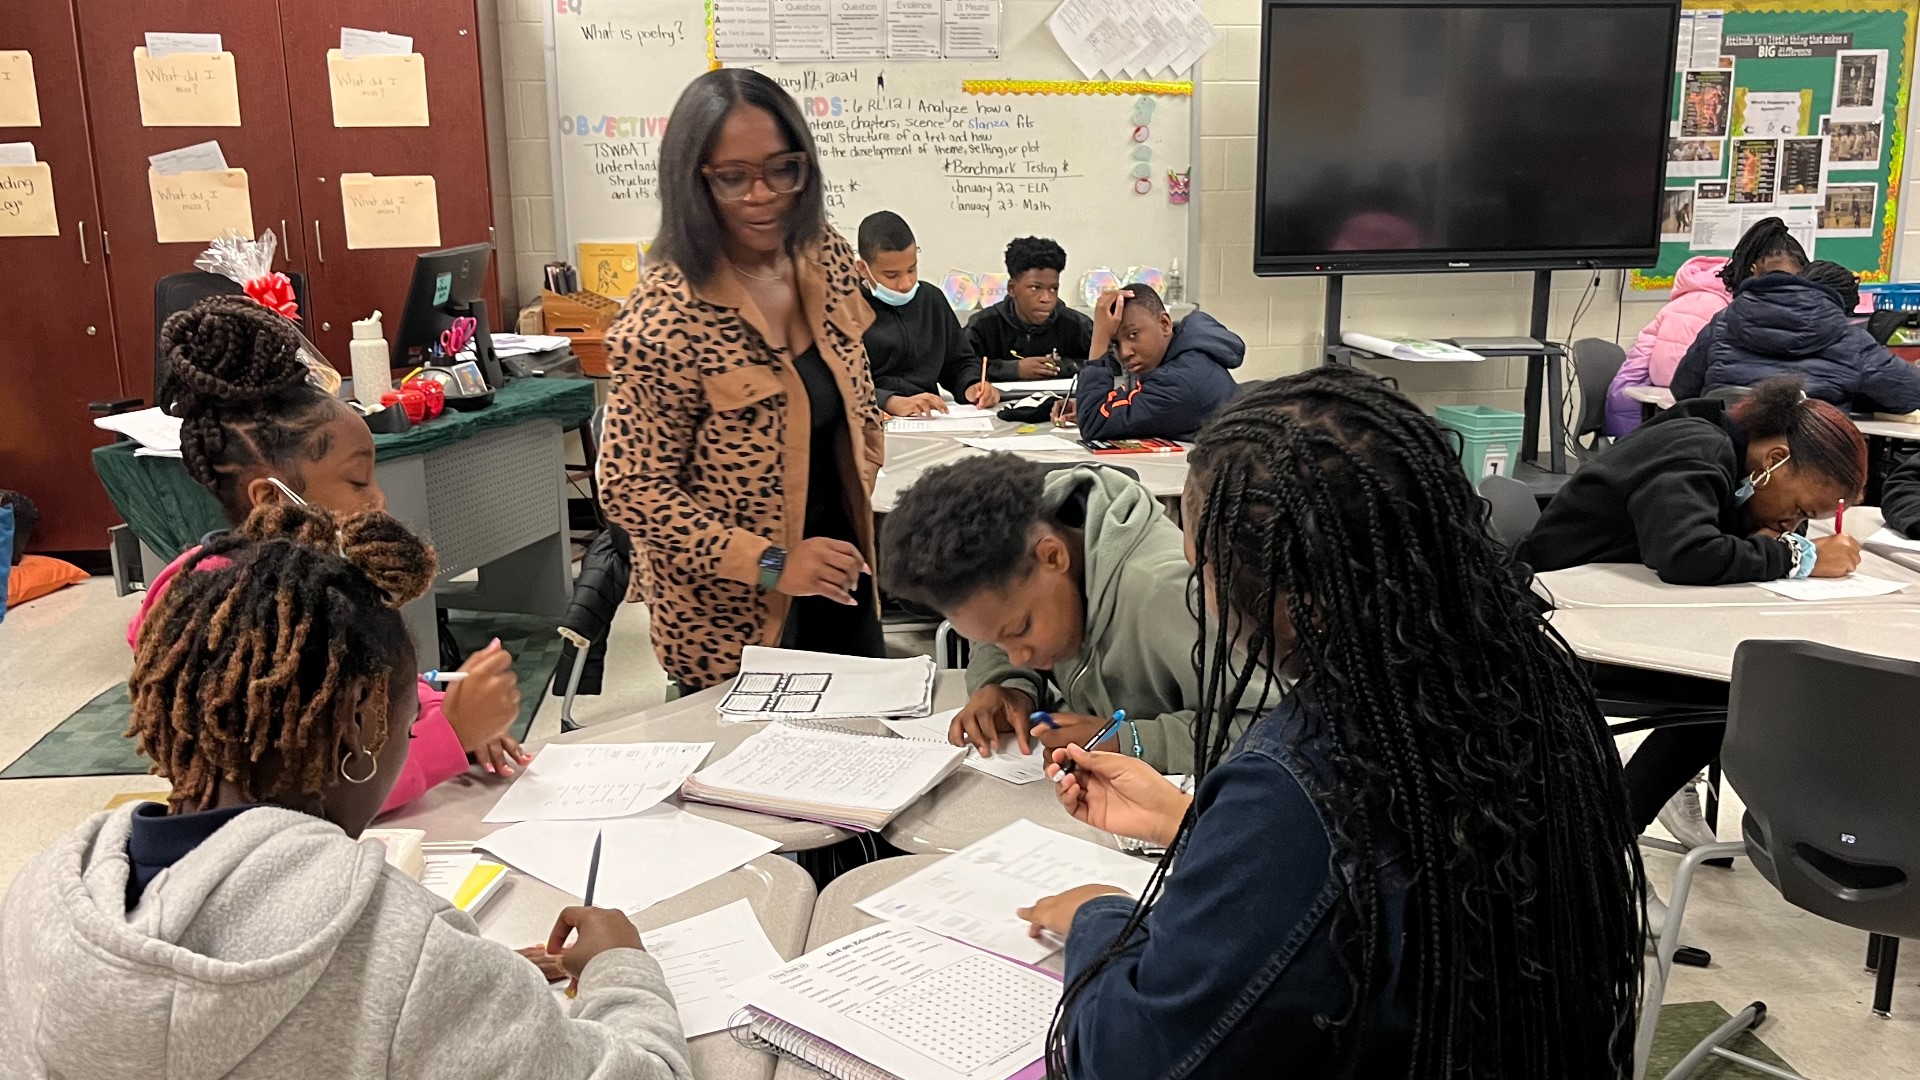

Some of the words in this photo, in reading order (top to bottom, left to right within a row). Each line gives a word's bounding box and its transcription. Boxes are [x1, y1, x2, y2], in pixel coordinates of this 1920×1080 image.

[556, 0, 582, 15] EQ
[786, 2, 821, 12] Question
[842, 2, 878, 12] Question
[896, 0, 932, 10] Evidence
[965, 3, 989, 11] Means
[581, 22, 614, 40] What
[621, 29, 632, 40] is
[638, 20, 684, 46] poetry?
[1768, 35, 1788, 46] little
[1790, 35, 1808, 47] thing
[1809, 34, 1822, 44] that
[1758, 46, 1776, 58] BIG
[1778, 46, 1812, 56] difference
[146, 66, 180, 82] What
[184, 70, 198, 82] did
[204, 70, 216, 80] I
[336, 72, 366, 86] What
[389, 78, 398, 86] I
[826, 68, 858, 84] 2024
[918, 100, 968, 122] Analyze
[976, 100, 1000, 114] how
[1004, 104, 1011, 113] a
[851, 114, 899, 134] chapters,
[952, 120, 964, 128] or
[1017, 114, 1034, 128] fits
[813, 132, 834, 143] rall
[896, 129, 910, 141] of
[913, 134, 920, 142] a
[926, 131, 947, 142] text
[949, 131, 968, 142] and
[972, 131, 992, 142] how
[584, 142, 650, 158] TSWBAT
[832, 146, 846, 158] the
[918, 143, 928, 154] of
[934, 144, 967, 156] theme,
[1008, 146, 1018, 154] or
[1022, 141, 1040, 158] plot
[158, 187, 187, 200] What
[209, 190, 218, 198] I
[612, 188, 630, 200] and
[952, 179, 992, 202] January
[996, 182, 1015, 194] 22
[350, 194, 377, 207] What
[399, 196, 406, 204] I
[1023, 198, 1051, 211] Math
